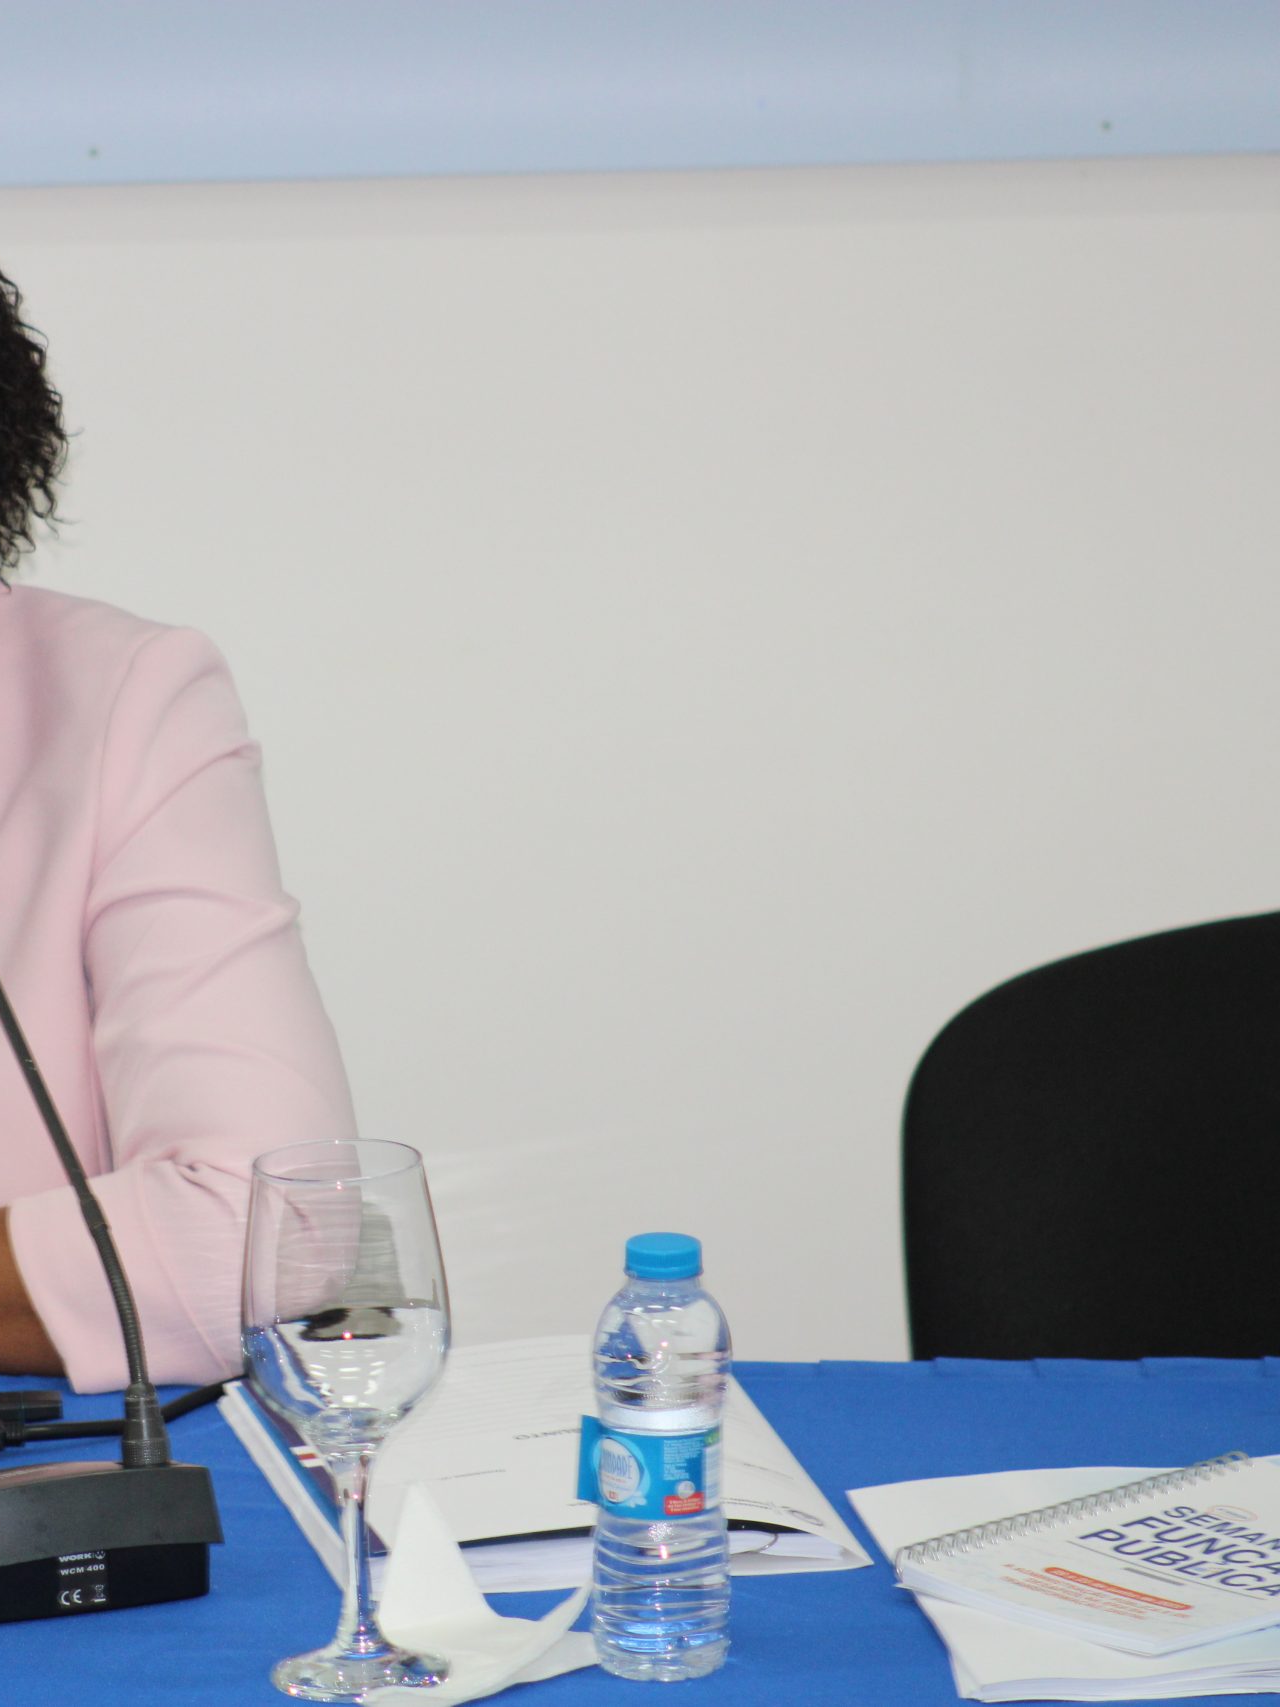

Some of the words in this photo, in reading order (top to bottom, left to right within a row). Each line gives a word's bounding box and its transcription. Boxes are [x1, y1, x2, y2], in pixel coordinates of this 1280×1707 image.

[58, 1552, 92, 1563] WORK
[60, 1566, 85, 1577] WCM
[86, 1564, 106, 1573] 400
